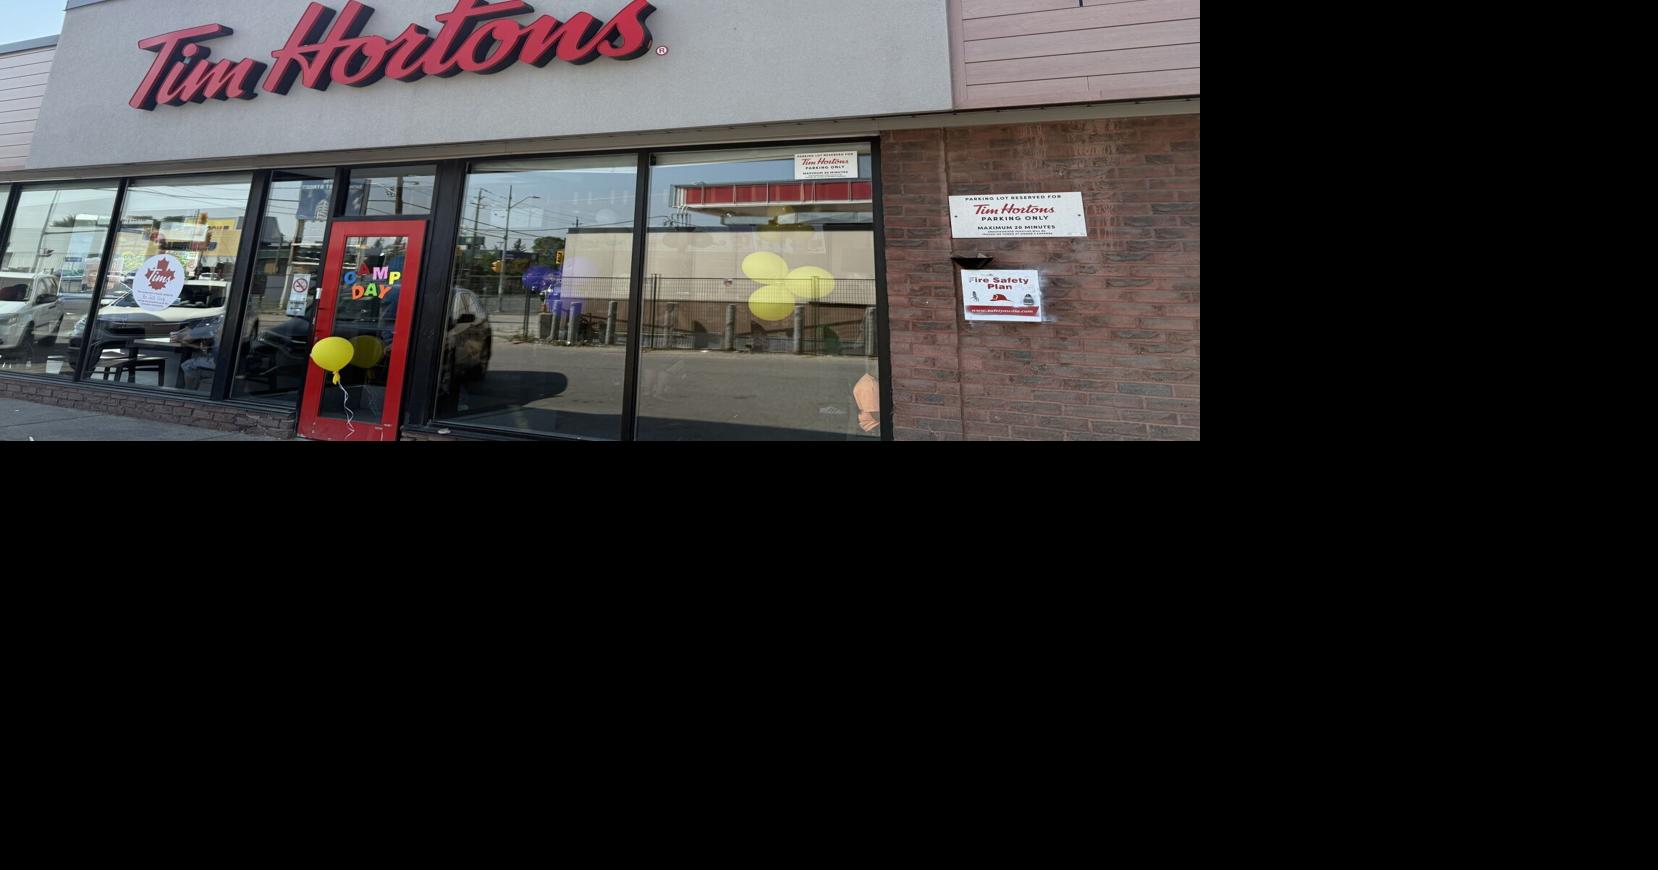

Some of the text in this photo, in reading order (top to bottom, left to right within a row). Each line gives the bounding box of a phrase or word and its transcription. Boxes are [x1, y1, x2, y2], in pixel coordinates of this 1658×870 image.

[129, 23, 263, 111] Tim
[263, 0, 657, 94] Hortons
[973, 203, 1055, 215] Tim Hortons
[148, 268, 172, 285] Tims
[993, 277, 1029, 285] Safety
[352, 283, 392, 300] DAY
